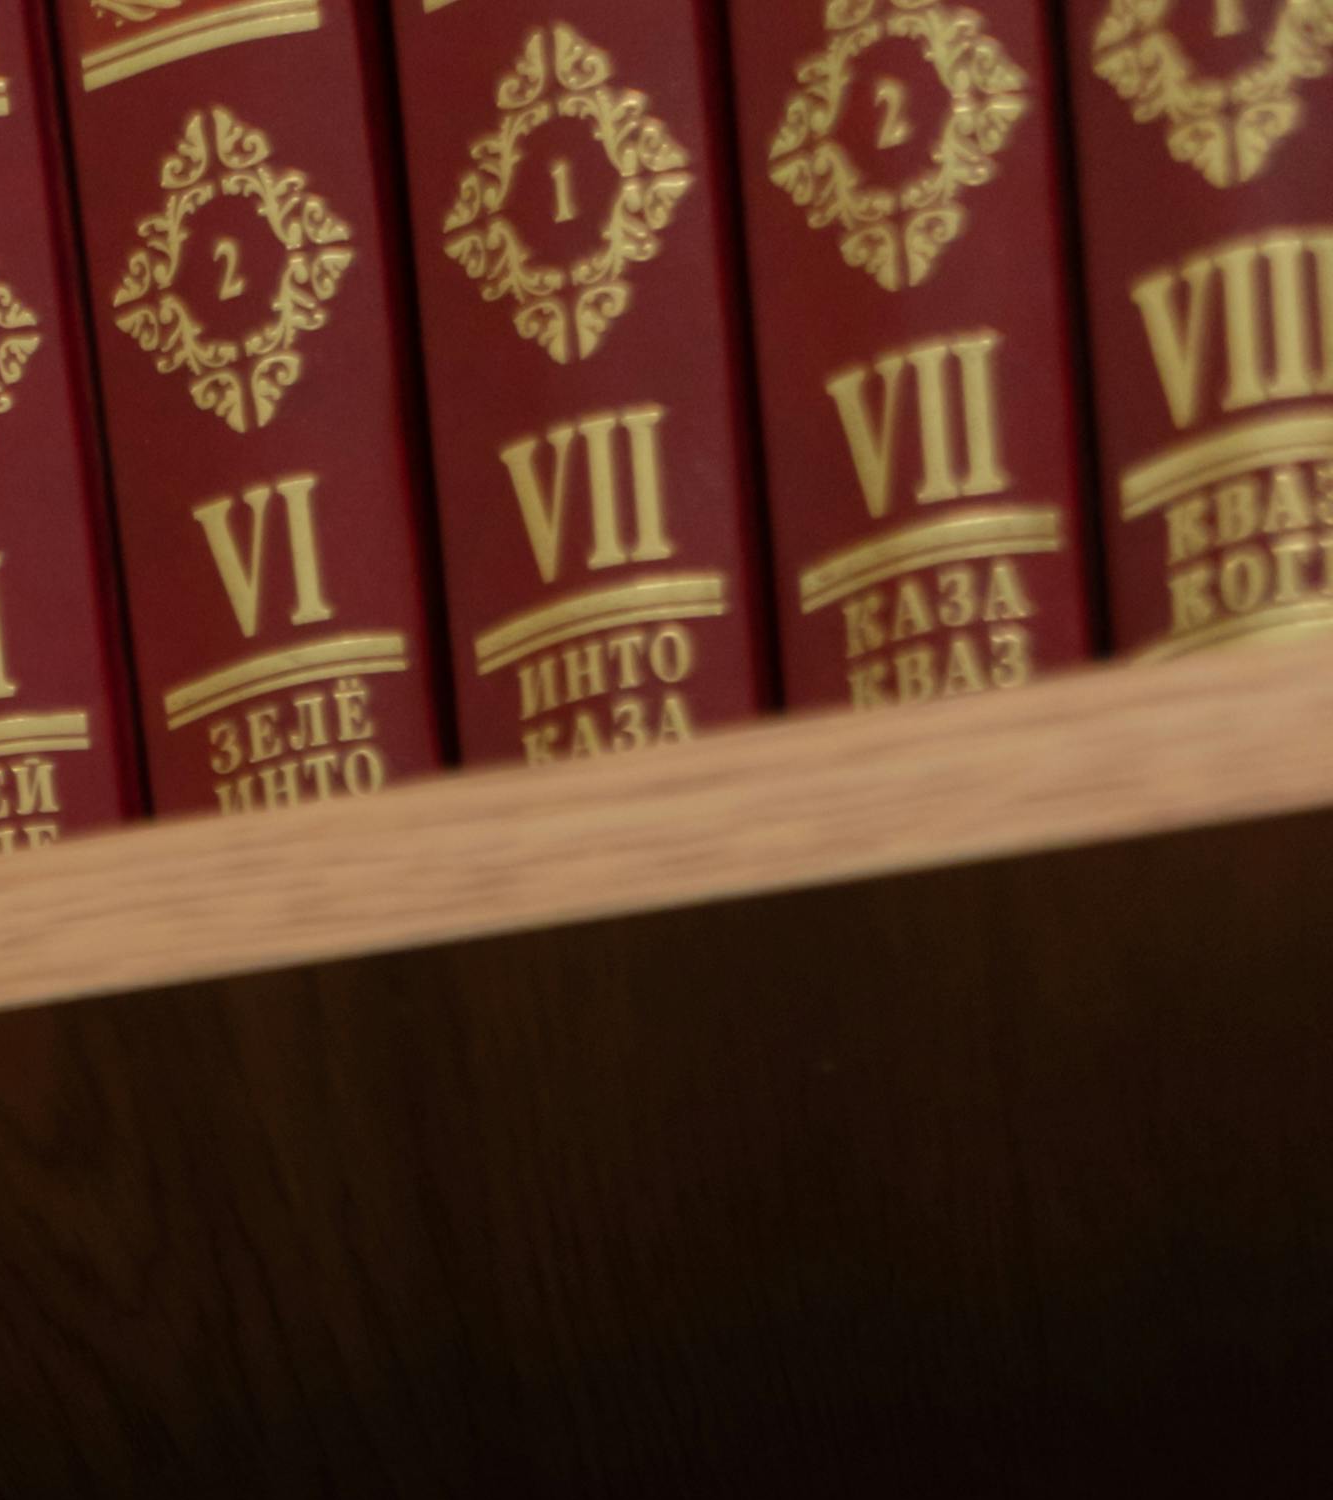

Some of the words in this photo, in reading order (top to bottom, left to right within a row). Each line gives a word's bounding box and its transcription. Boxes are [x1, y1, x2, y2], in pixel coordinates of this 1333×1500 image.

[873, 77, 913, 151] 2
[550, 158, 577, 225] 1
[212, 238, 247, 302] 2
[824, 328, 1013, 520] VII
[500, 404, 676, 586] VII
[192, 473, 334, 639] VI
[841, 558, 1035, 662] КАЗА
[517, 621, 695, 722] ИНТО
[848, 623, 1035, 712] КВАЗ
[209, 678, 377, 776] ЗЕЛЁ
